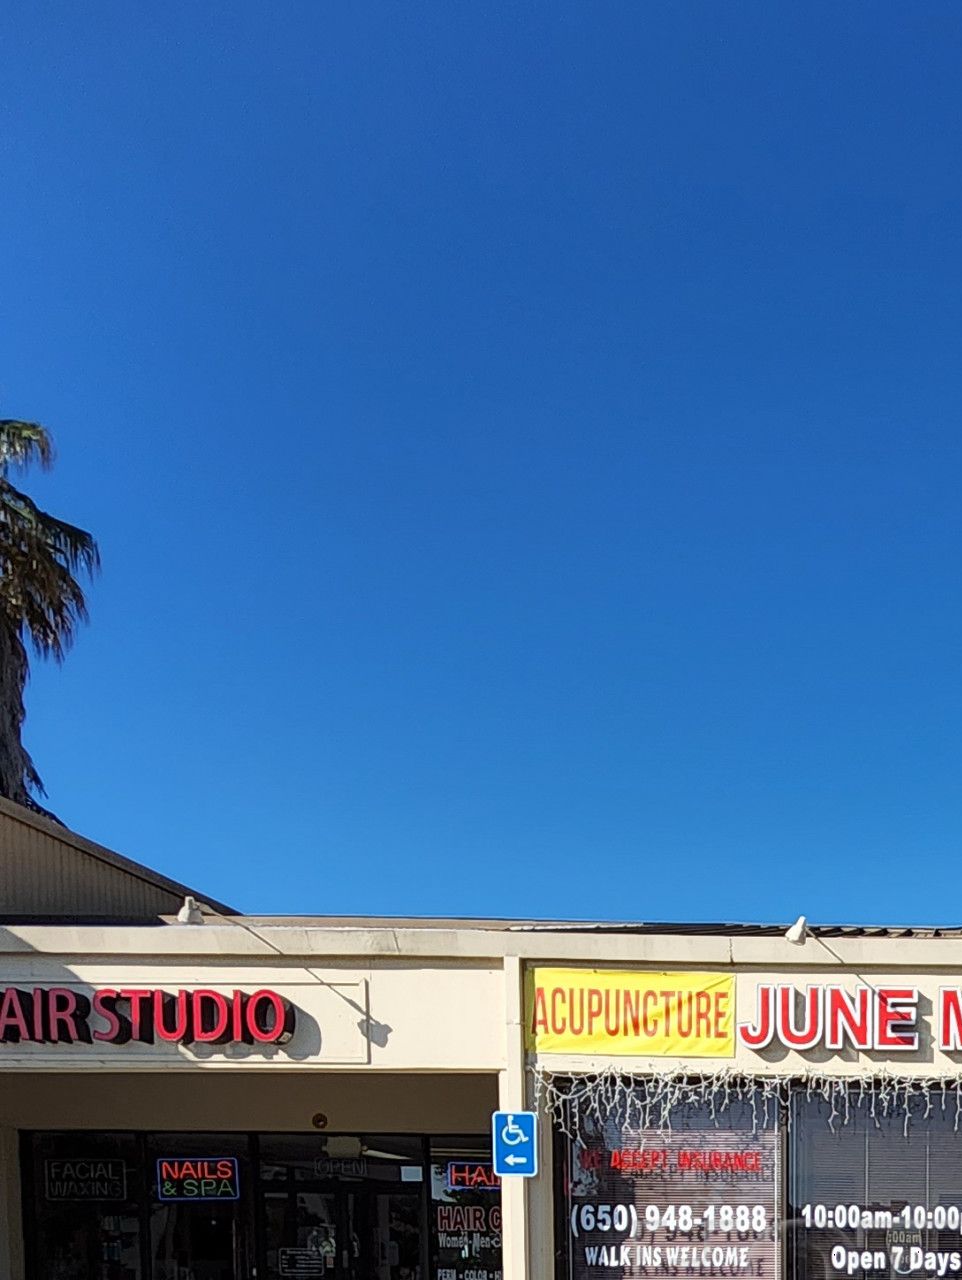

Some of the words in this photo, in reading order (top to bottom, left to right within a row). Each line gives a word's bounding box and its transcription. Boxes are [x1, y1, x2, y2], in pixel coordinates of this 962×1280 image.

[93, 989, 285, 1042] STUDIO
[531, 986, 728, 1038] ACUPUNCTURE
[737, 984, 919, 1050] JUNE
[50, 1162, 119, 1179] FACIAL
[161, 1161, 233, 1179] NAILS
[317, 1159, 364, 1175] OPEN
[611, 1150, 668, 1168] ACCEPT
[677, 1151, 763, 1172] INSURANCE
[450, 1165, 501, 1185] HAI
[50, 1180, 121, 1196] WAXING
[162, 1181, 177, 1196] &
[184, 1180, 235, 1196] SPA
[438, 1206, 486, 1231] HAIR
[571, 1204, 637, 1237] (650)
[645, 1205, 767, 1232] 948-1888
[585, 1246, 631, 1267] WALK
[636, 1246, 662, 1267] INS
[667, 1247, 749, 1267] WELCOME
[831, 1246, 885, 1274] Open
[891, 1247, 903, 1270] 7
[909, 1246, 961, 1275] Days
